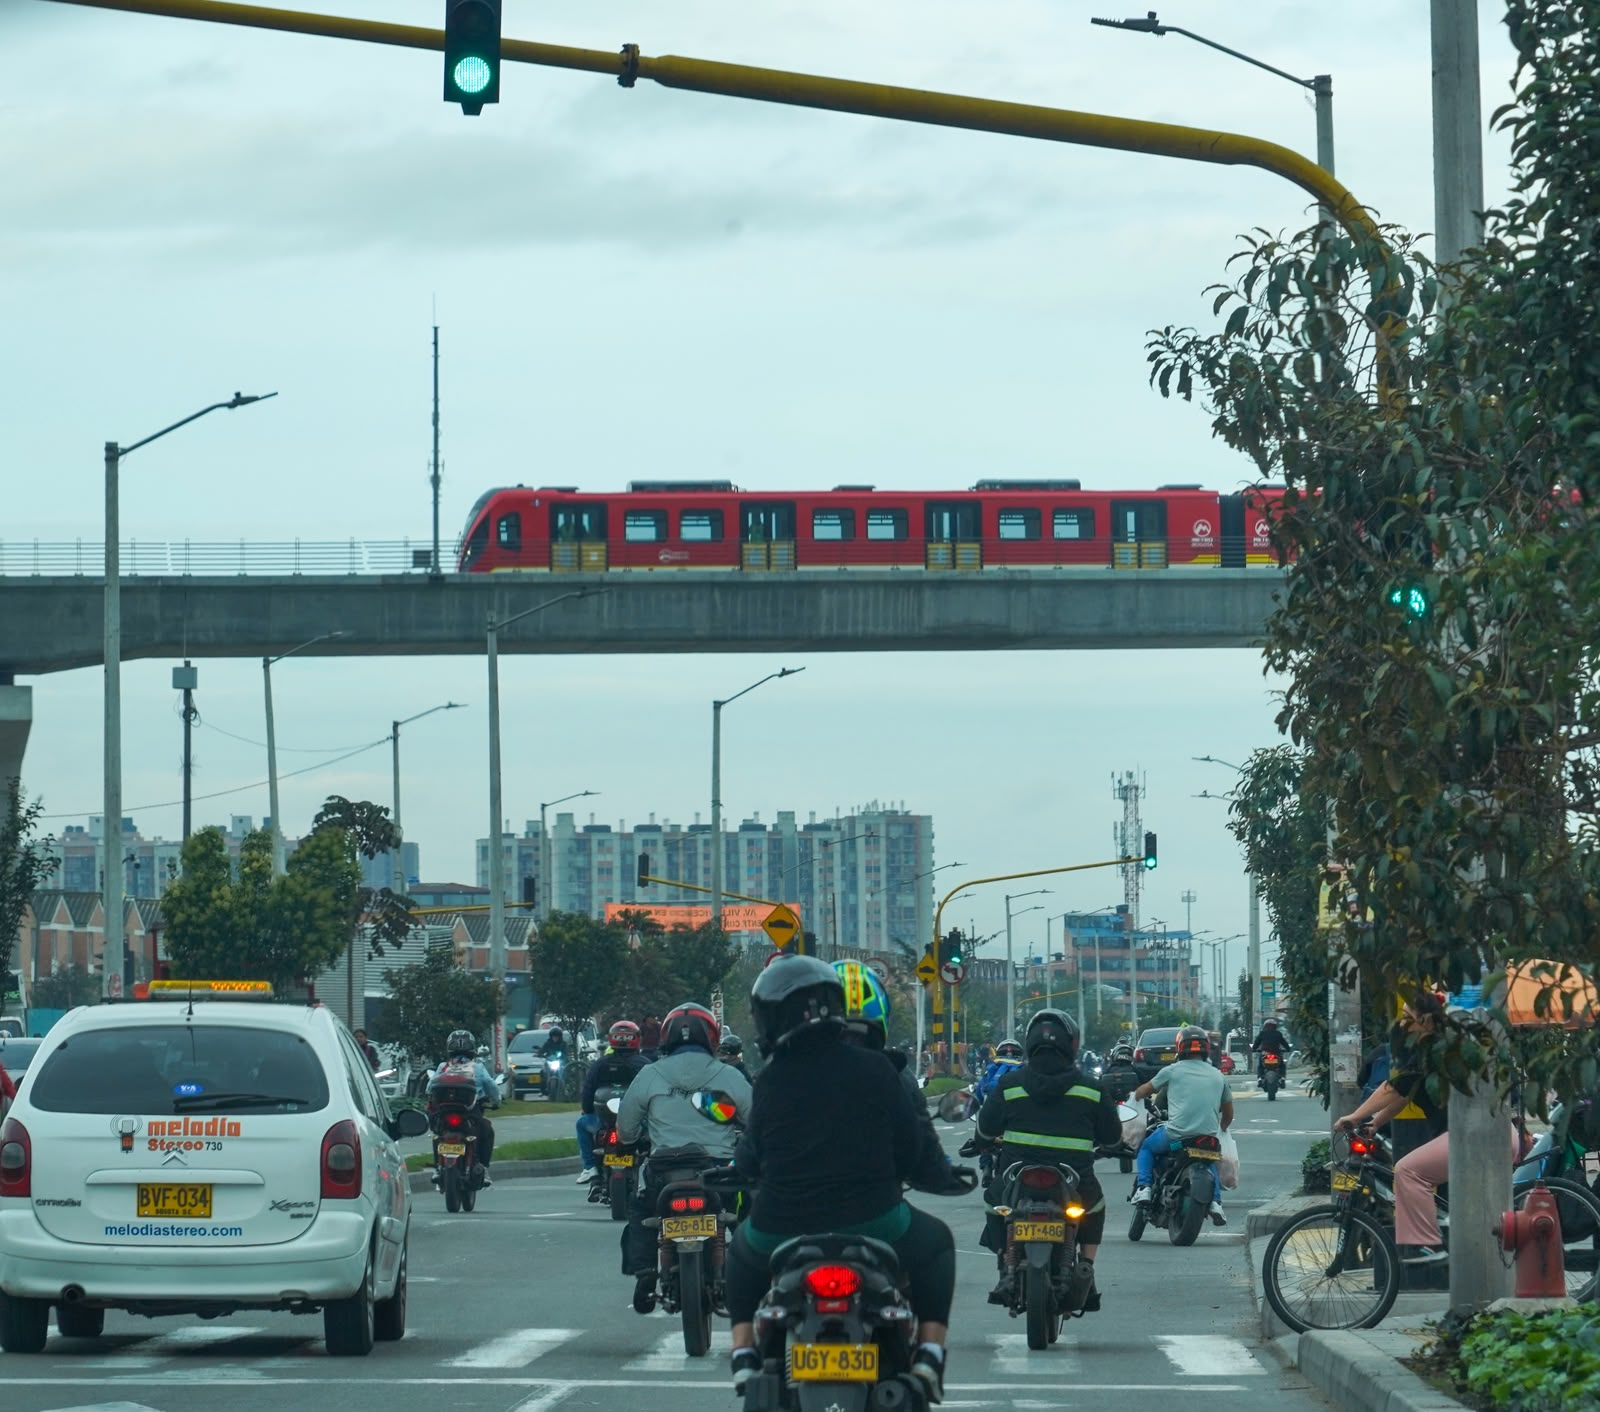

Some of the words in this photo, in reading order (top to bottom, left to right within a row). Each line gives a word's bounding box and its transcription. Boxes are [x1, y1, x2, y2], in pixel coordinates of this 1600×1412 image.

[147, 1138, 204, 1151] Stereo
[205, 1141, 223, 1151] 730
[104, 1224, 243, 1237] melodiastereo.com
